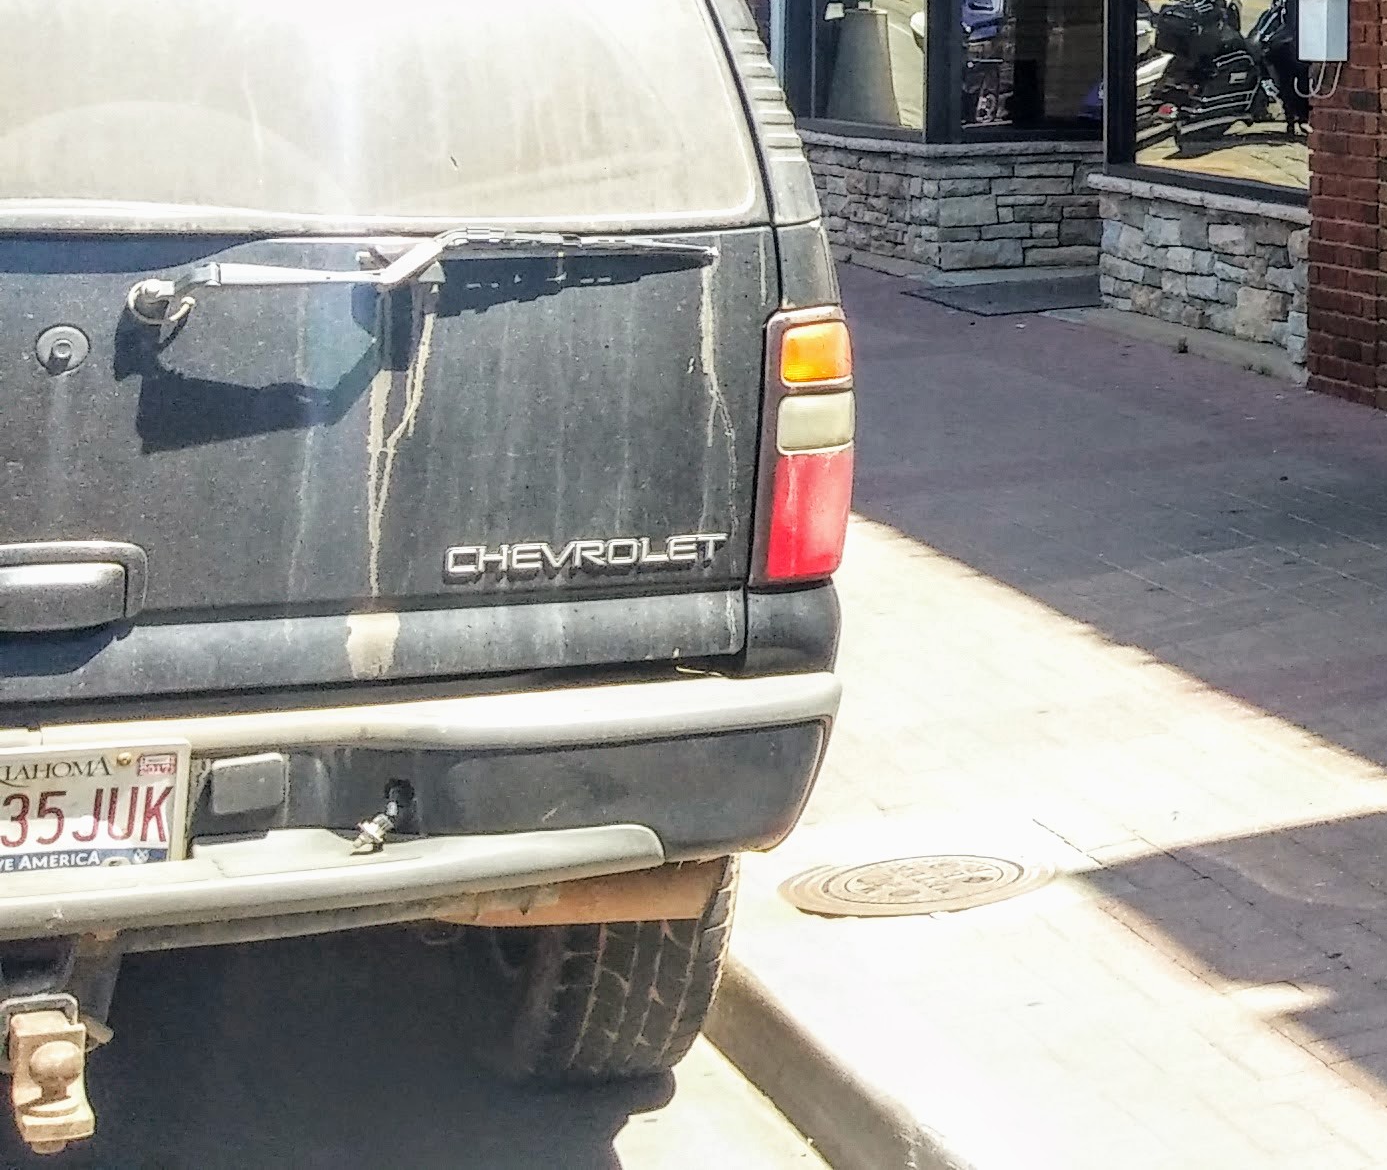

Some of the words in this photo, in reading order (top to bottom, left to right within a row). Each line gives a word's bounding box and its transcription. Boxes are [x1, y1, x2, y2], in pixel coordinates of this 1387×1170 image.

[446, 532, 729, 574] CHEVROLET
[0, 756, 111, 781] LAHOMA
[0, 790, 66, 847] 35
[72, 786, 174, 842] JUK
[18, 851, 100, 870] AMERICA
